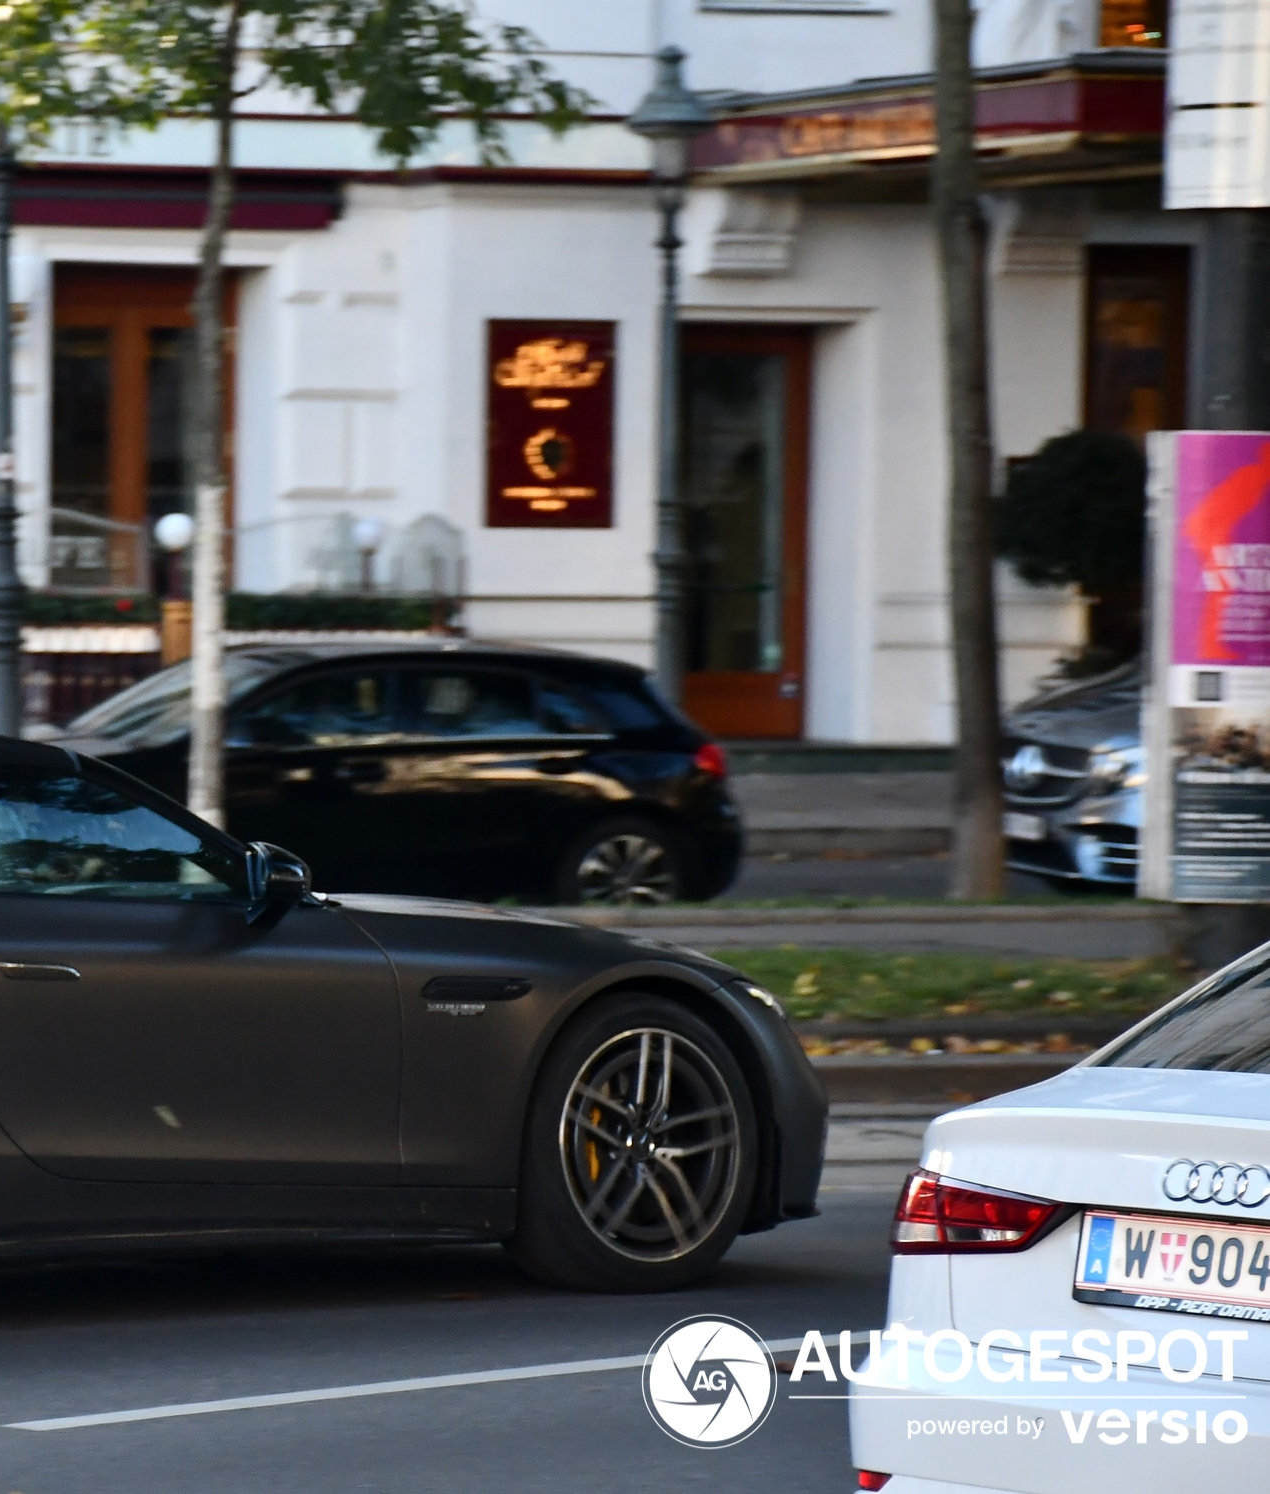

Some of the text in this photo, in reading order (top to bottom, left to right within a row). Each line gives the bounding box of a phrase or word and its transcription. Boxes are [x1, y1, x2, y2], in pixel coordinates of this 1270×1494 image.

[1090, 1259, 1103, 1275] A
[1125, 1227, 1270, 1292] W 904
